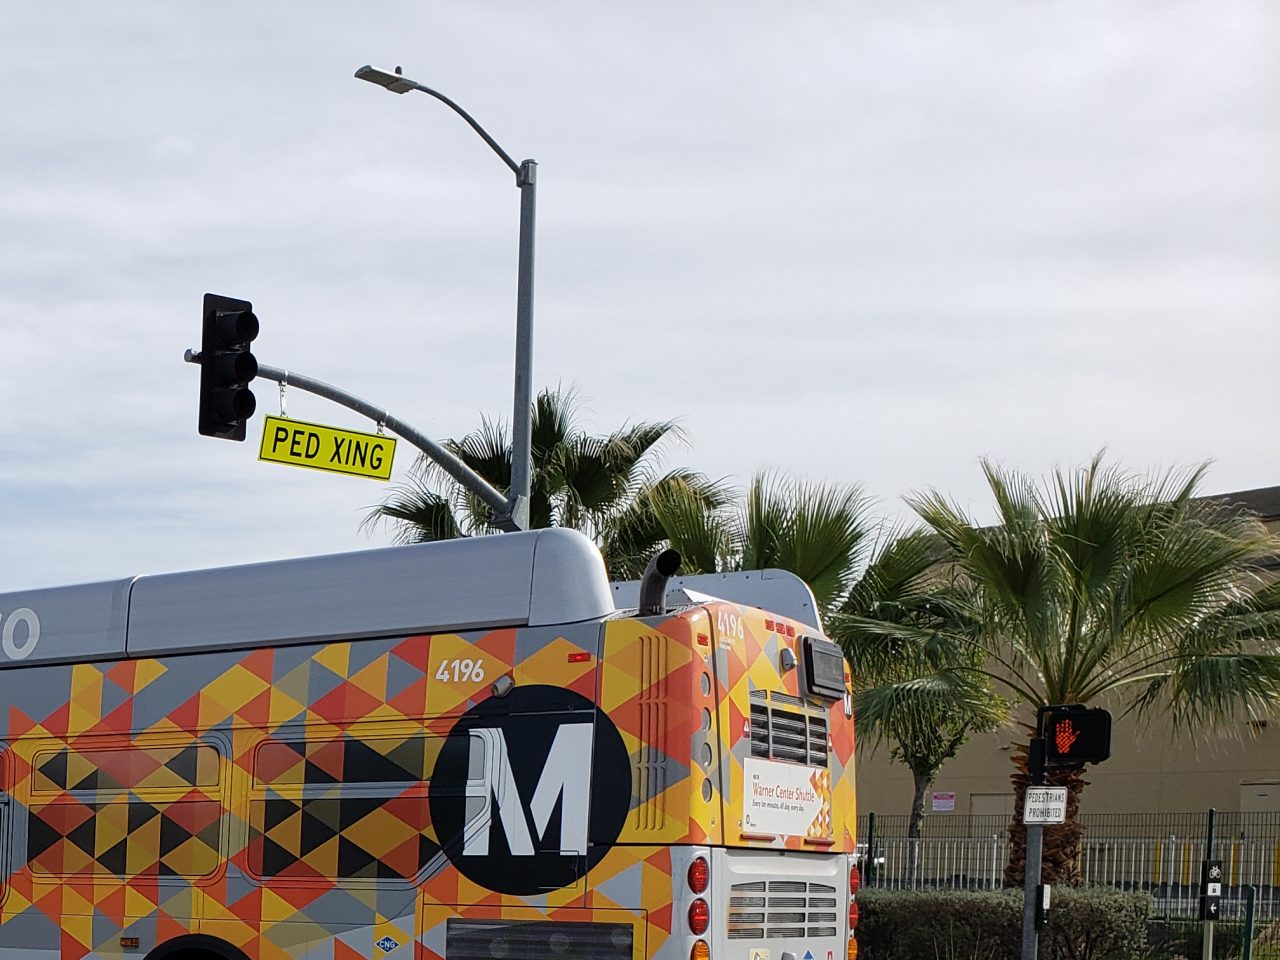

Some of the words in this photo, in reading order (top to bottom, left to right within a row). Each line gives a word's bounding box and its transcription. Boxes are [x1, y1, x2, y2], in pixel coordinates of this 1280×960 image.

[272, 426, 320, 459] PED
[330, 436, 384, 471] XING
[717, 610, 744, 640] 4196
[435, 658, 485, 683] 4196
[462, 722, 594, 856] M
[752, 782, 774, 798] Warner
[775, 785, 794, 800] Center
[795, 786, 815, 802] Shuttle
[1028, 792, 1065, 803] PEDESTRIANS
[1028, 807, 1062, 818] PROHIBITED
[379, 940, 396, 948] CNG
